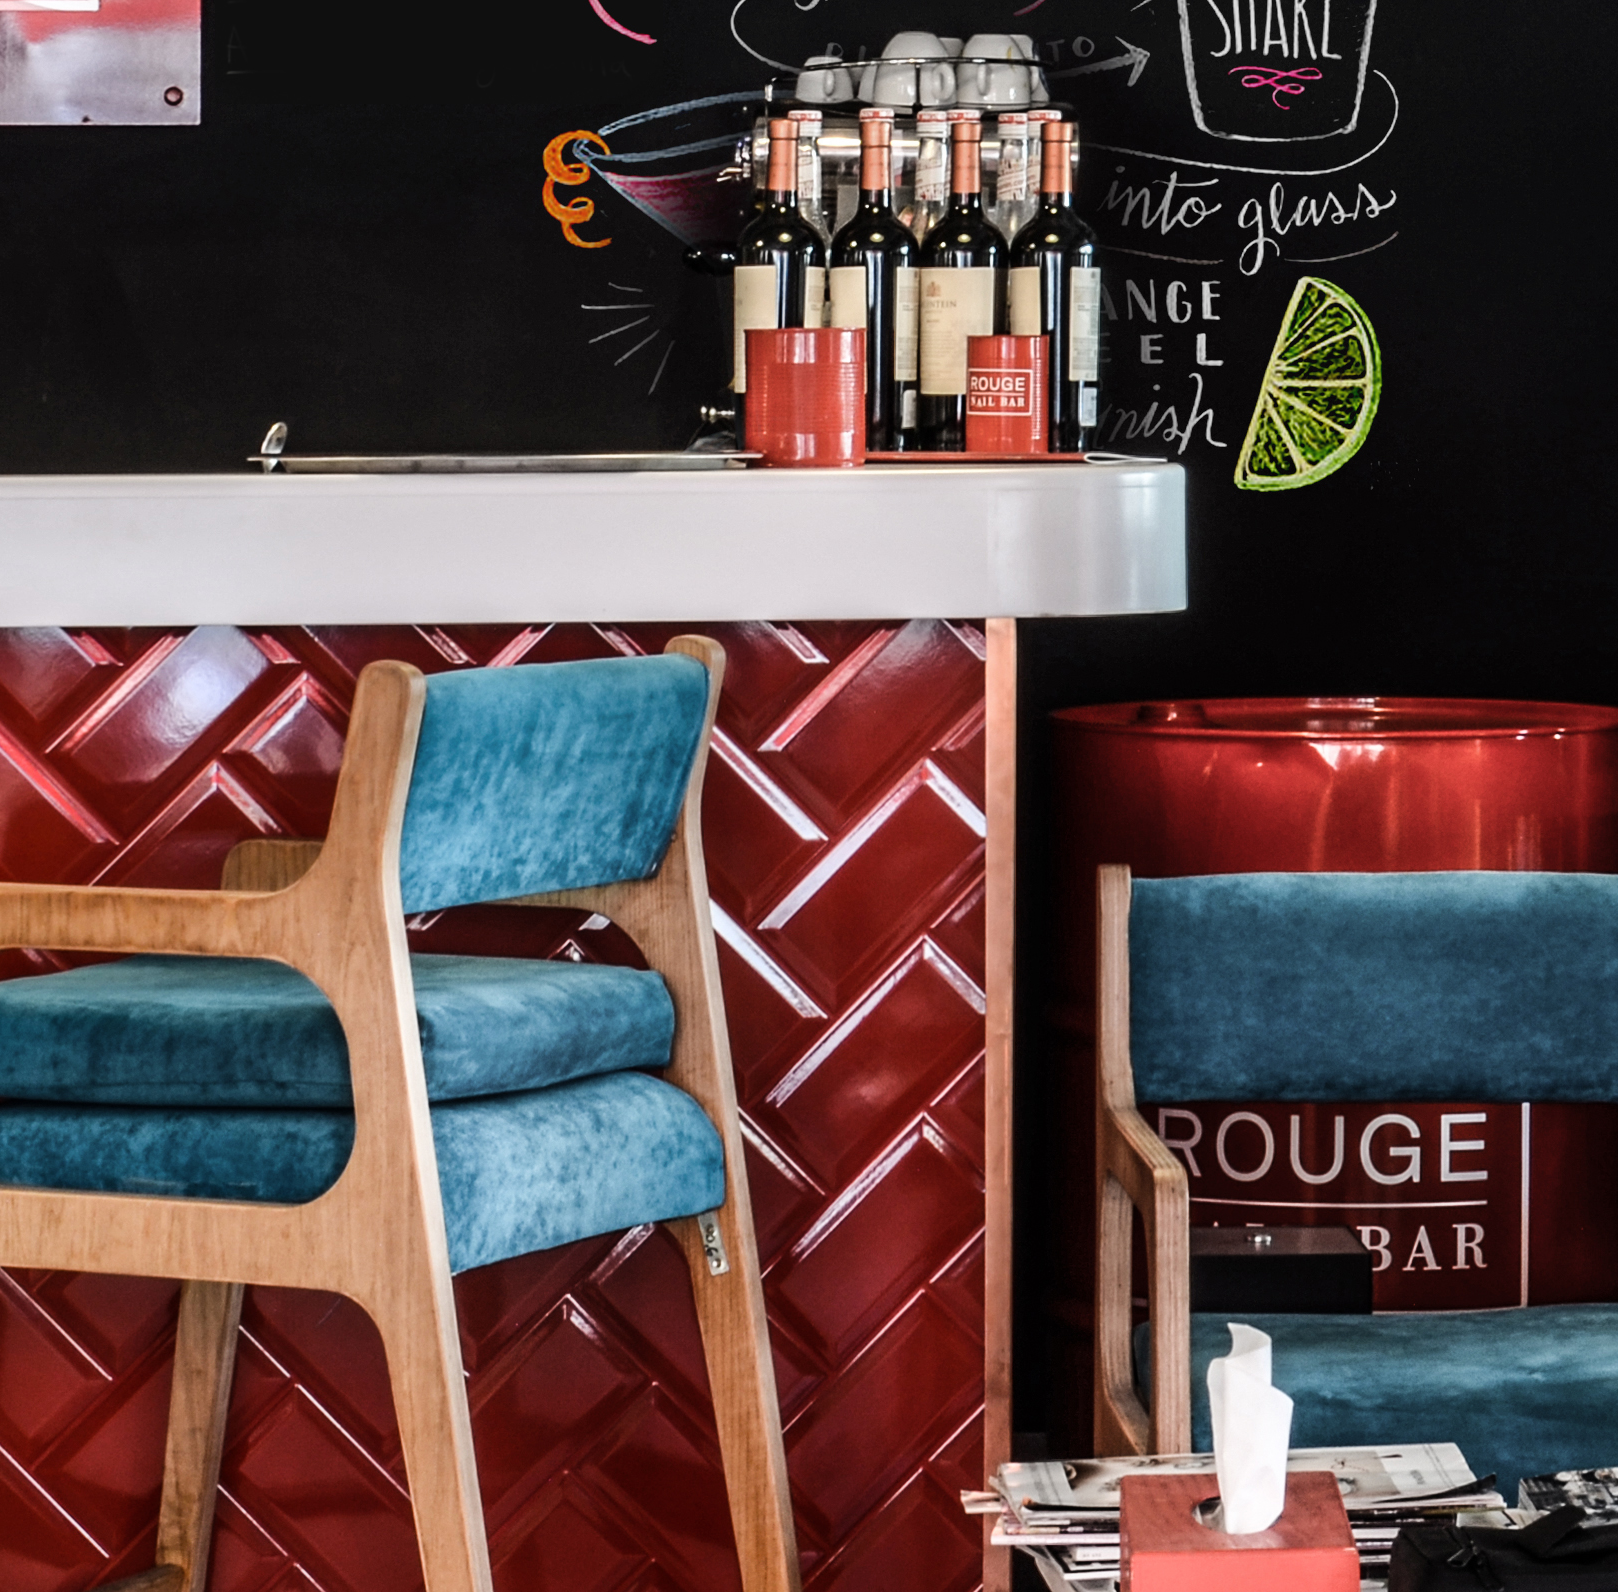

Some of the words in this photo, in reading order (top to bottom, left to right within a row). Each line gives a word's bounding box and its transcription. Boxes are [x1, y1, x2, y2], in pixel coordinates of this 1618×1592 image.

[1097, 169, 1222, 236] into
[1237, 169, 1397, 276] glass
[971, 376, 1026, 392] ROUGE
[1158, 1109, 1489, 1185] ROUGE
[1356, 1222, 1488, 1272] BAR
